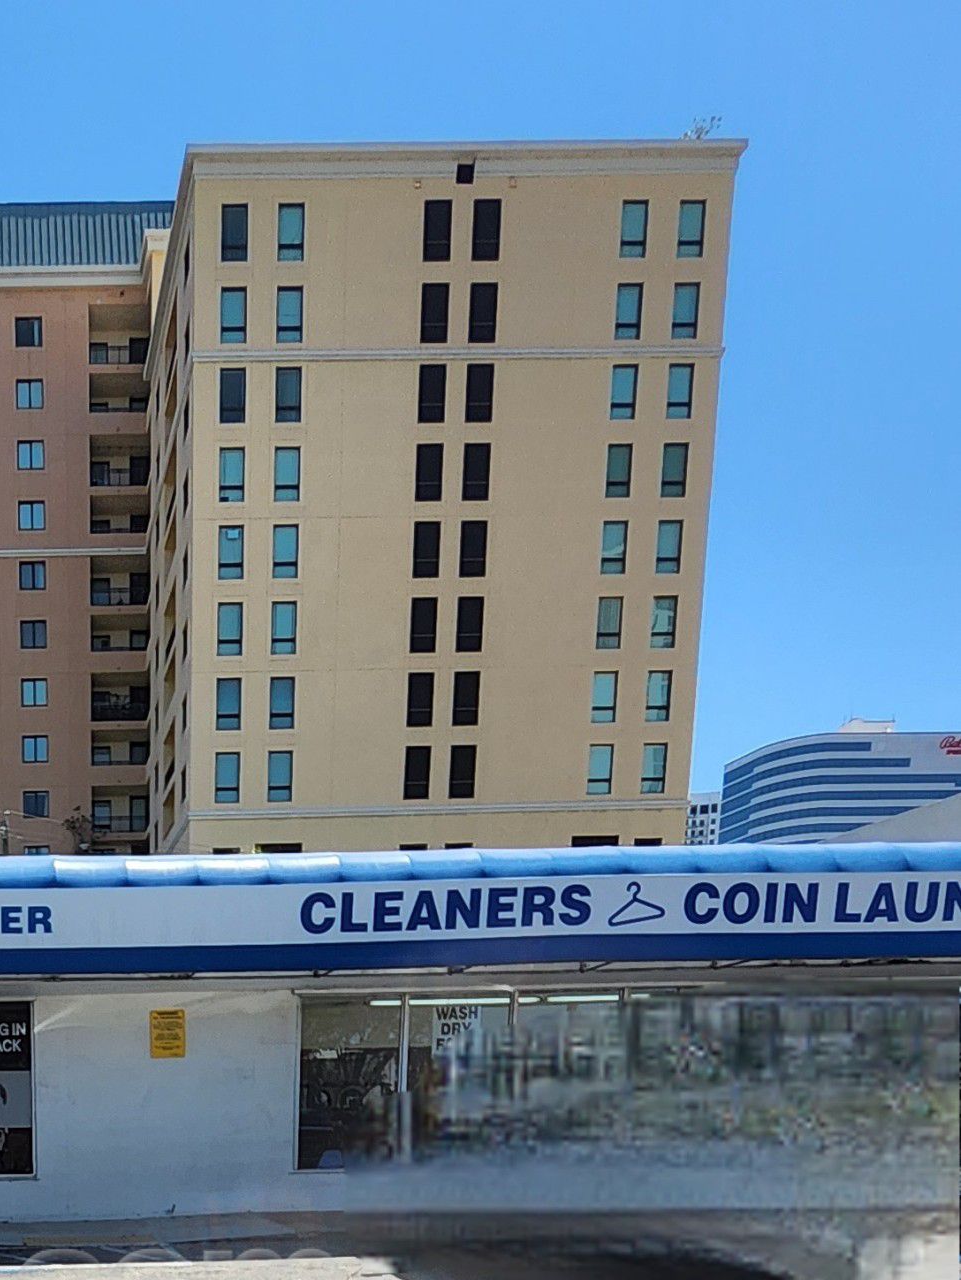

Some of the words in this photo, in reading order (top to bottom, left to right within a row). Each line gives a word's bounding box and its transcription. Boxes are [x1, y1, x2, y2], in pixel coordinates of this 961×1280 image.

[299, 885, 592, 935] CLEANERS
[683, 881, 820, 926] COIN
[435, 1005, 478, 1021] WASH
[11, 1022, 27, 1036] IN
[440, 1021, 472, 1036] DRY
